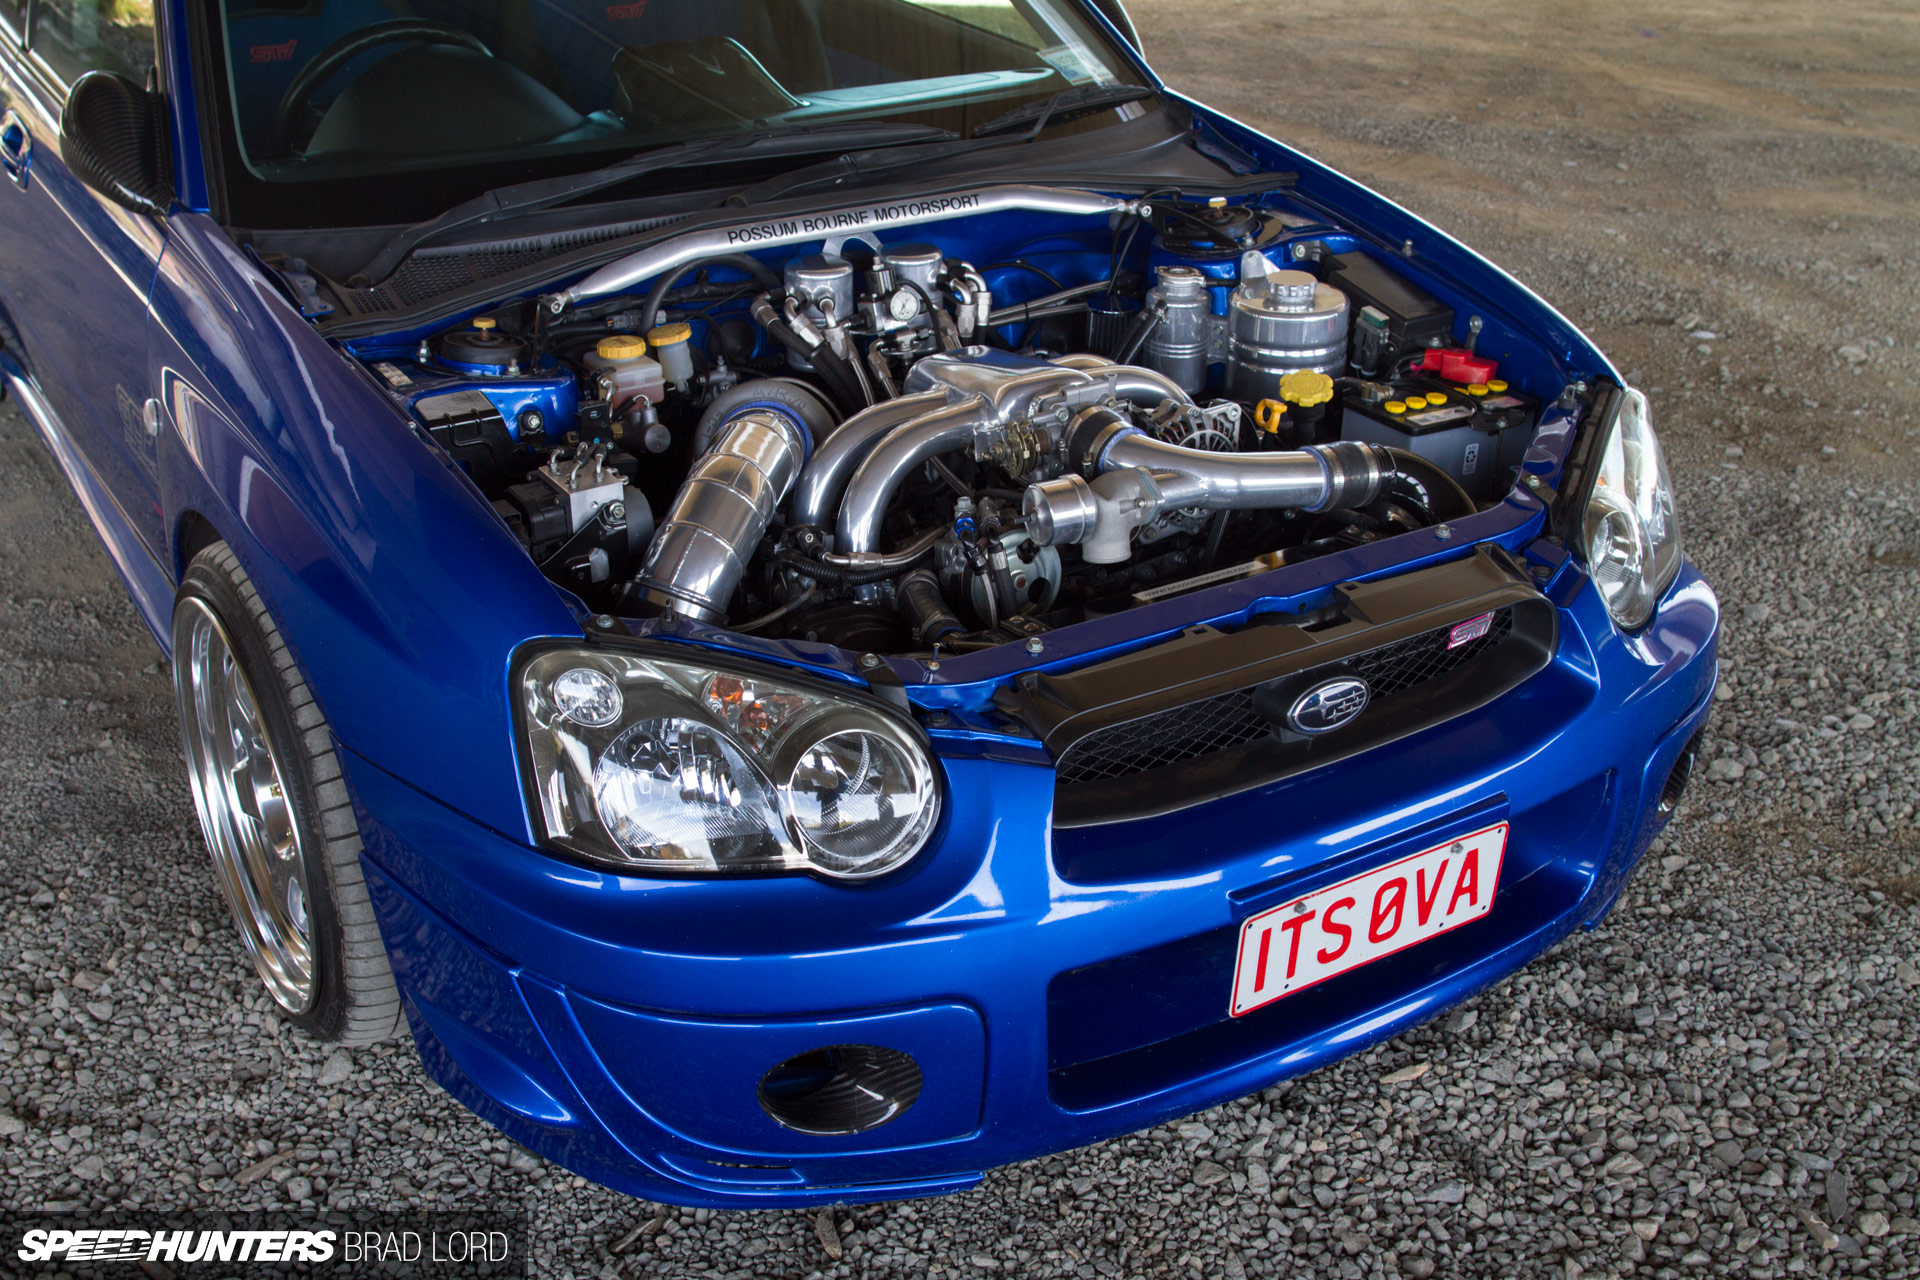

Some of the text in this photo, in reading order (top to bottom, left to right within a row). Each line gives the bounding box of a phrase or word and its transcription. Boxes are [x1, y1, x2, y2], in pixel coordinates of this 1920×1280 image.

[727, 194, 981, 244] POSSUM BOURNE MOTORSPORT
